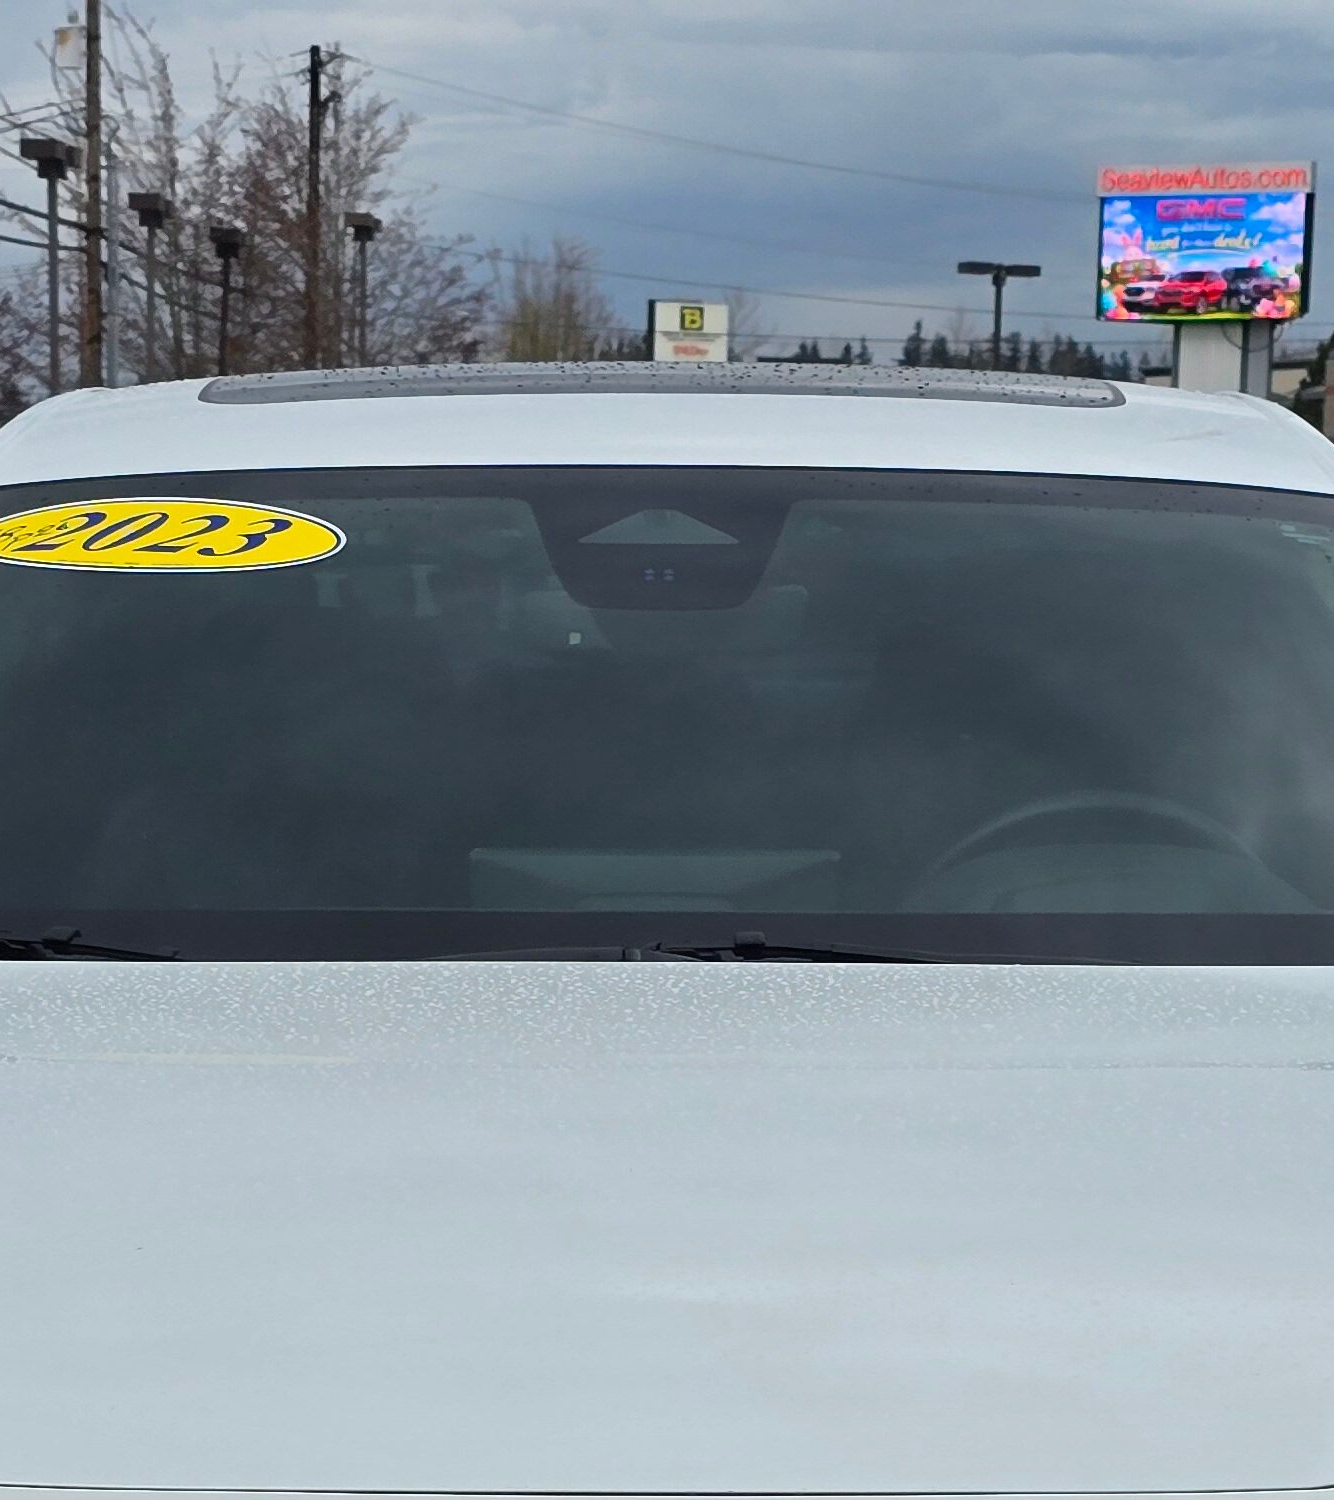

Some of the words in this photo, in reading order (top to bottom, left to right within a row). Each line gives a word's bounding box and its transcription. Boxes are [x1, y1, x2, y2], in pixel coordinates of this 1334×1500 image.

[1102, 167, 1307, 191] SeaviewAutos.com
[1156, 197, 1247, 221] GMC
[11, 512, 293, 557] 2023
